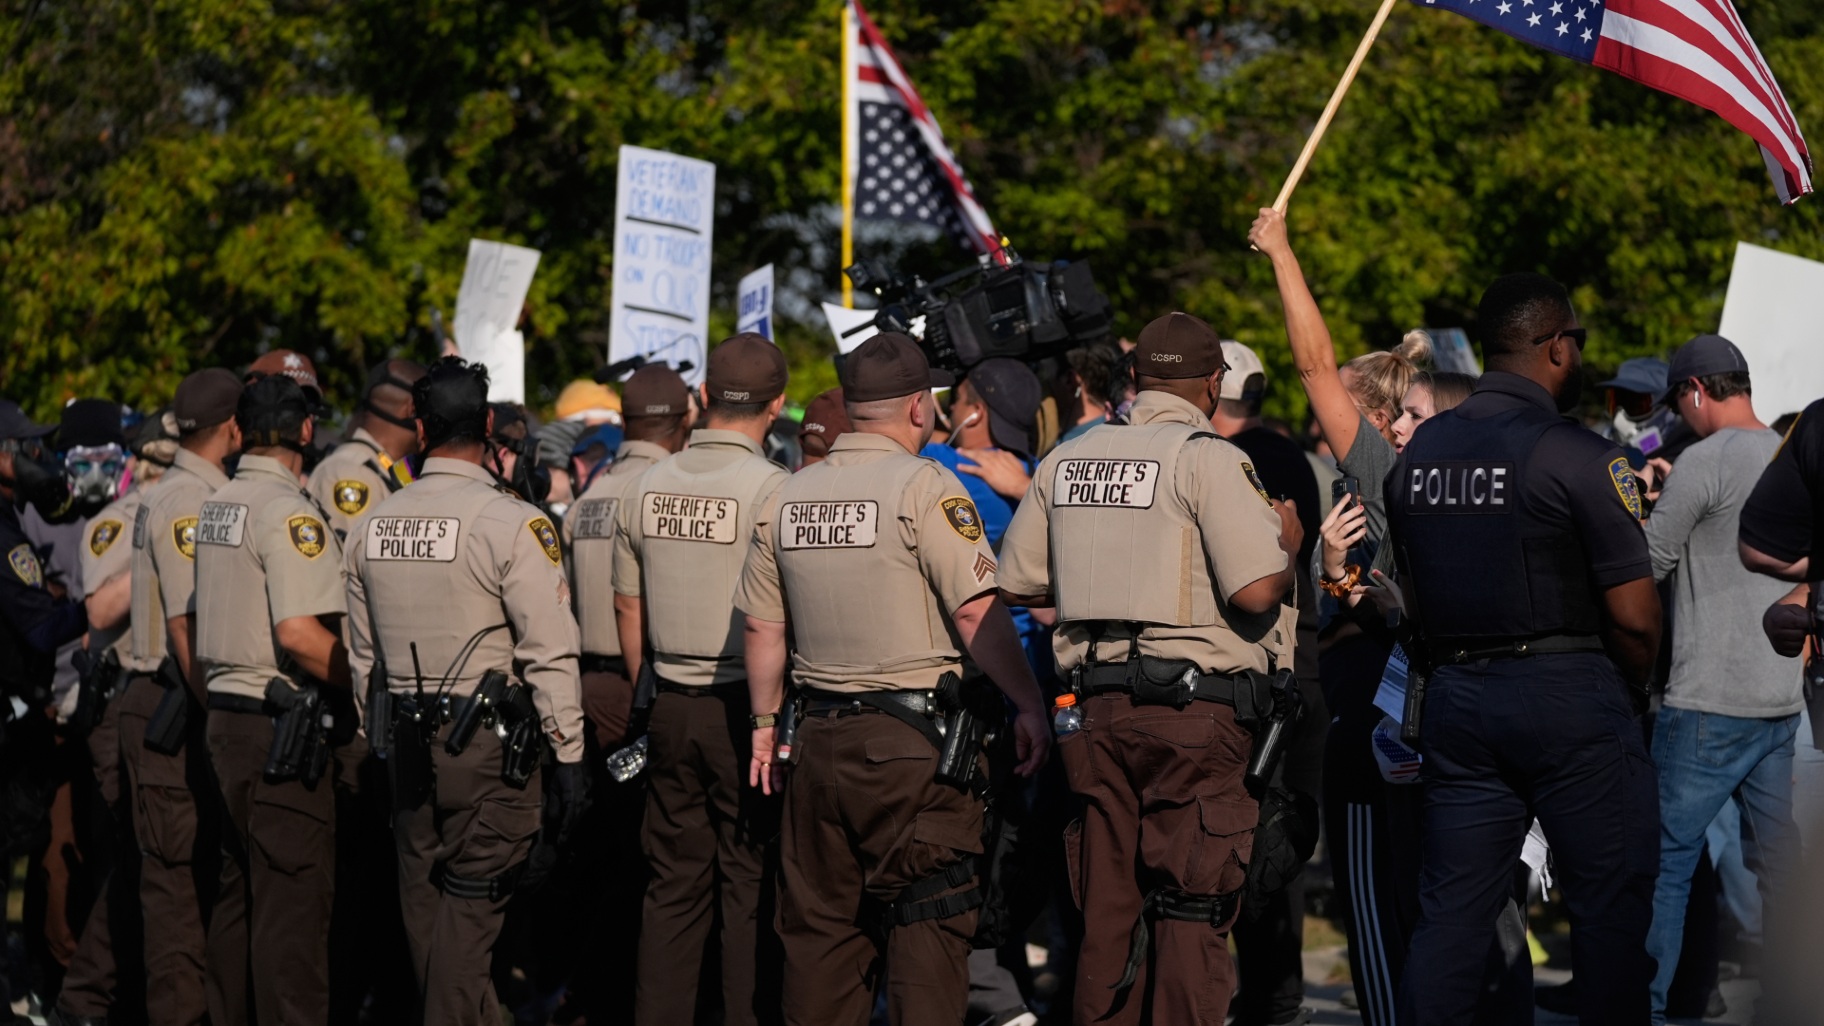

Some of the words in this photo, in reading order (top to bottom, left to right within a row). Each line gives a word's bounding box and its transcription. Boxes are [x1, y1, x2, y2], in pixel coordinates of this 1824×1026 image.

[626, 159, 708, 198] VETERANS
[629, 189, 702, 226] DEMAND
[624, 231, 650, 260] NO
[654, 234, 709, 274] TROOPS
[623, 267, 646, 284] ON
[652, 270, 698, 321] OUR
[1150, 352, 1182, 363] CCSPD
[724, 391, 750, 401] CCSPD
[1064, 462, 1147, 483] SHERIFF'S
[1068, 482, 1133, 504] POLICE
[1410, 467, 1507, 506] POLICE
[652, 496, 727, 520] SHERIFF'S
[789, 503, 866, 524] SHERIFF'S
[201, 522, 232, 543] POLICE
[375, 519, 448, 539] SHERIFF'S
[657, 516, 716, 540] POLICE
[795, 524, 856, 546] POLICE
[380, 539, 437, 559] POLICE
